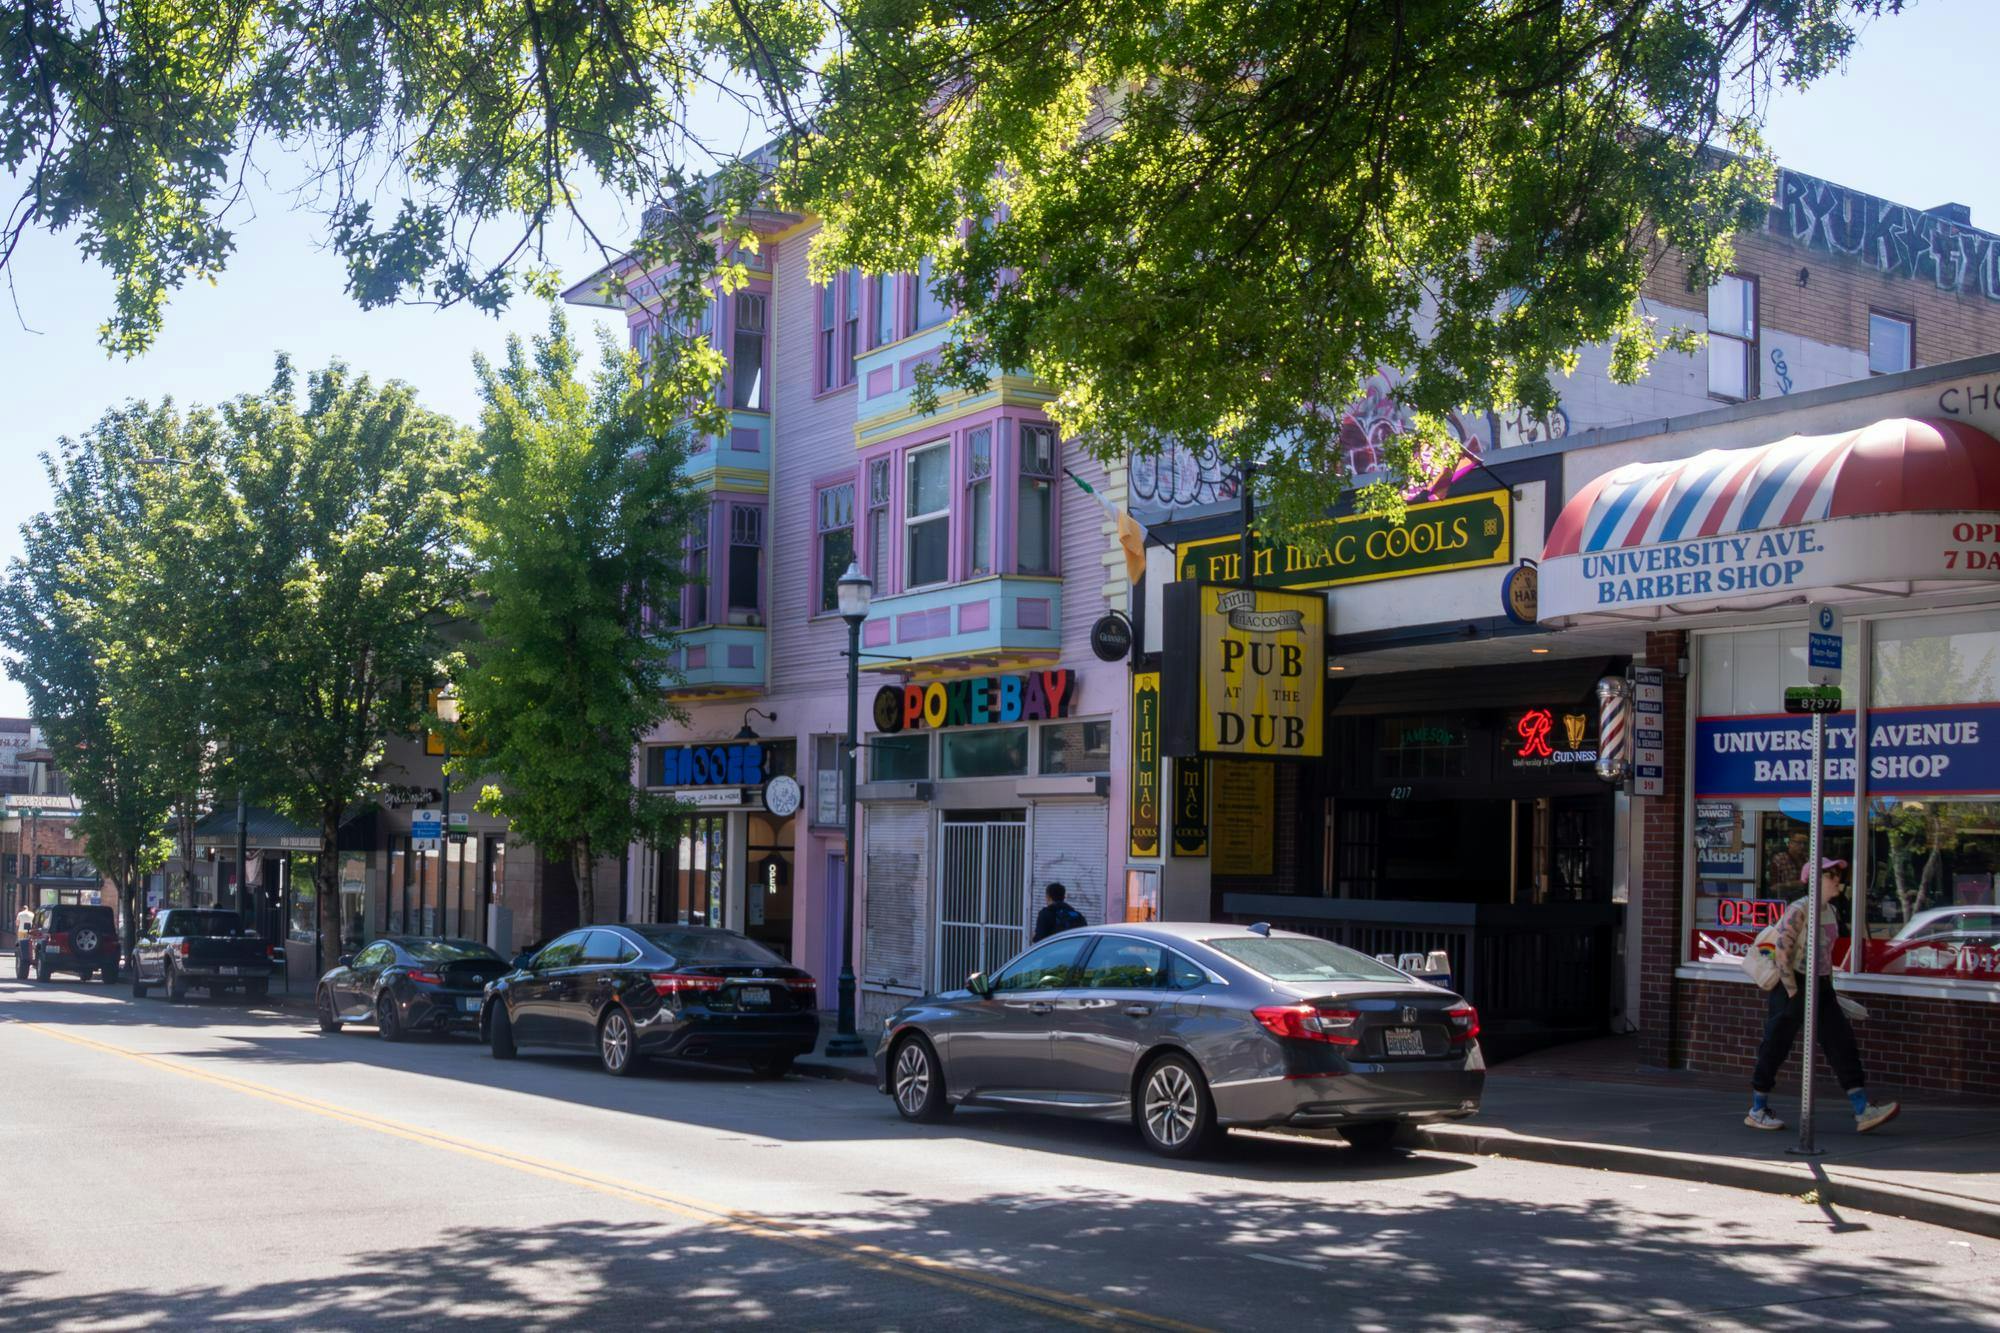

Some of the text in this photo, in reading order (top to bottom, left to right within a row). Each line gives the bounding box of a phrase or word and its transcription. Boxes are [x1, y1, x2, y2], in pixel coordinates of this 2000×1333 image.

[1365, 517, 1468, 561] COOLS
[1583, 529, 1825, 580] UNIVERSITY AVE.
[1943, 551, 1959, 569] 7
[1598, 559, 1804, 604] BARBER SHOP
[1220, 638, 1303, 678] PUB
[904, 668, 1069, 730] POKE BAY
[1224, 685, 1300, 702] AT THE
[1801, 698, 1840, 709] 87977
[1217, 710, 1304, 749] DUB
[1713, 723, 1979, 753] UNIVERSTY AVENUE
[1871, 755, 1950, 779] SHOP
[1390, 786, 1412, 799] 4217
[1719, 900, 1785, 927] OPEN
